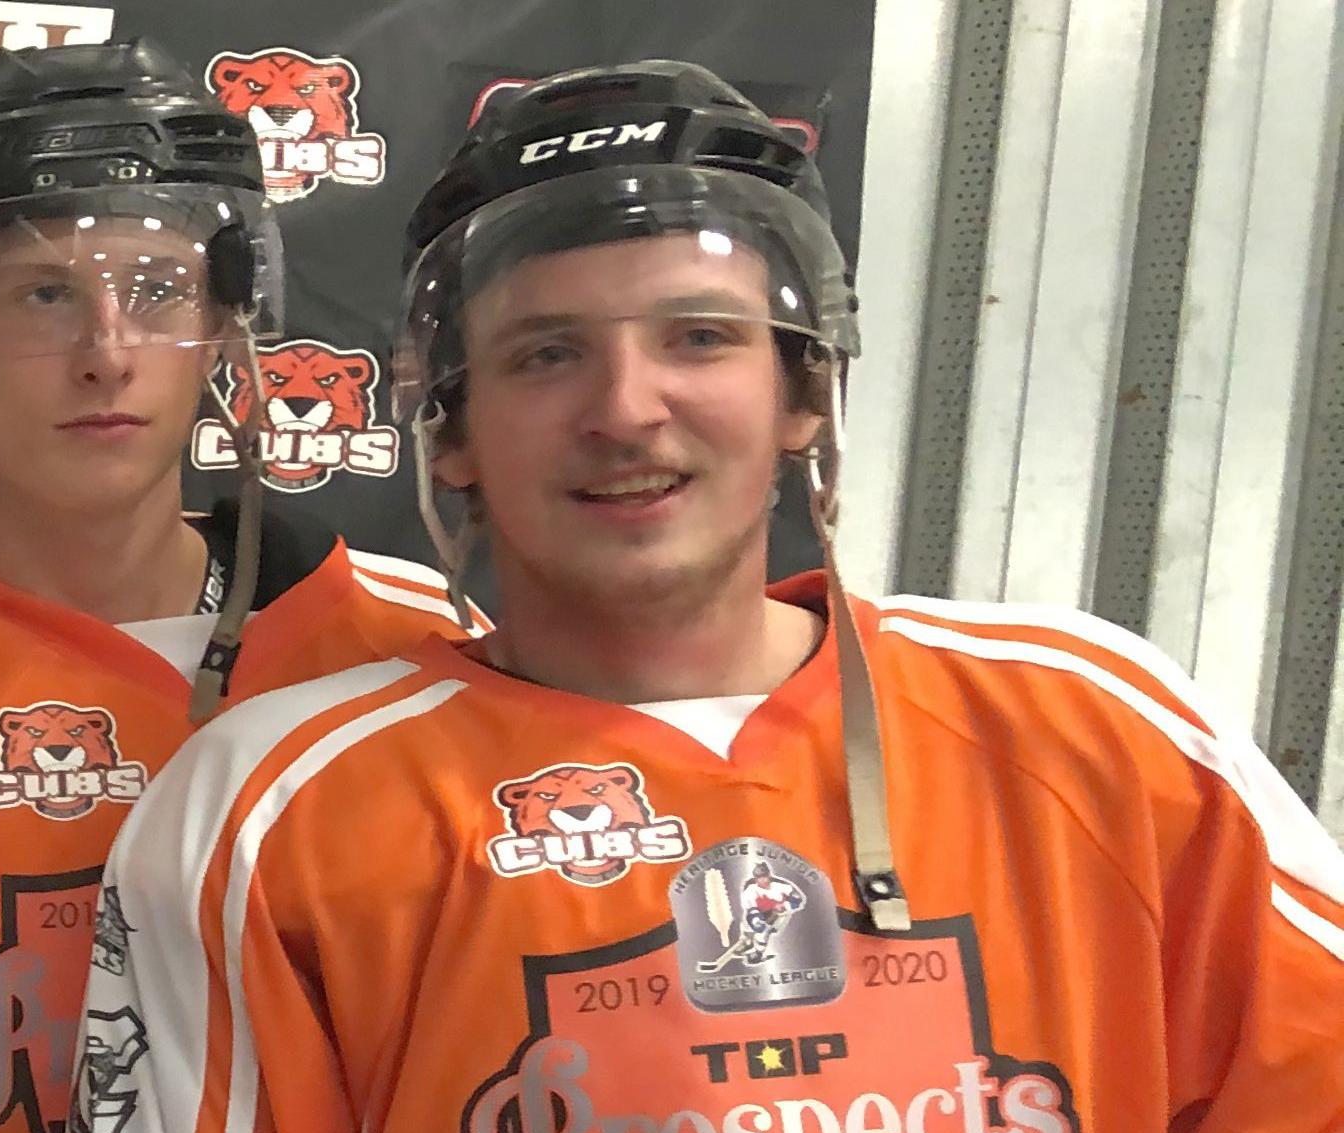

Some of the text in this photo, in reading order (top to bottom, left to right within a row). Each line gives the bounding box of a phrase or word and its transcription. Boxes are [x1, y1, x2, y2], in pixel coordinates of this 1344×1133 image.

[519, 121, 667, 164] CCM
[491, 821, 687, 872] CUBS
[40, 901, 97, 929] 201
[863, 951, 947, 988] 2020
[575, 974, 670, 1013] 2019
[690, 1032, 848, 1084] TOP
